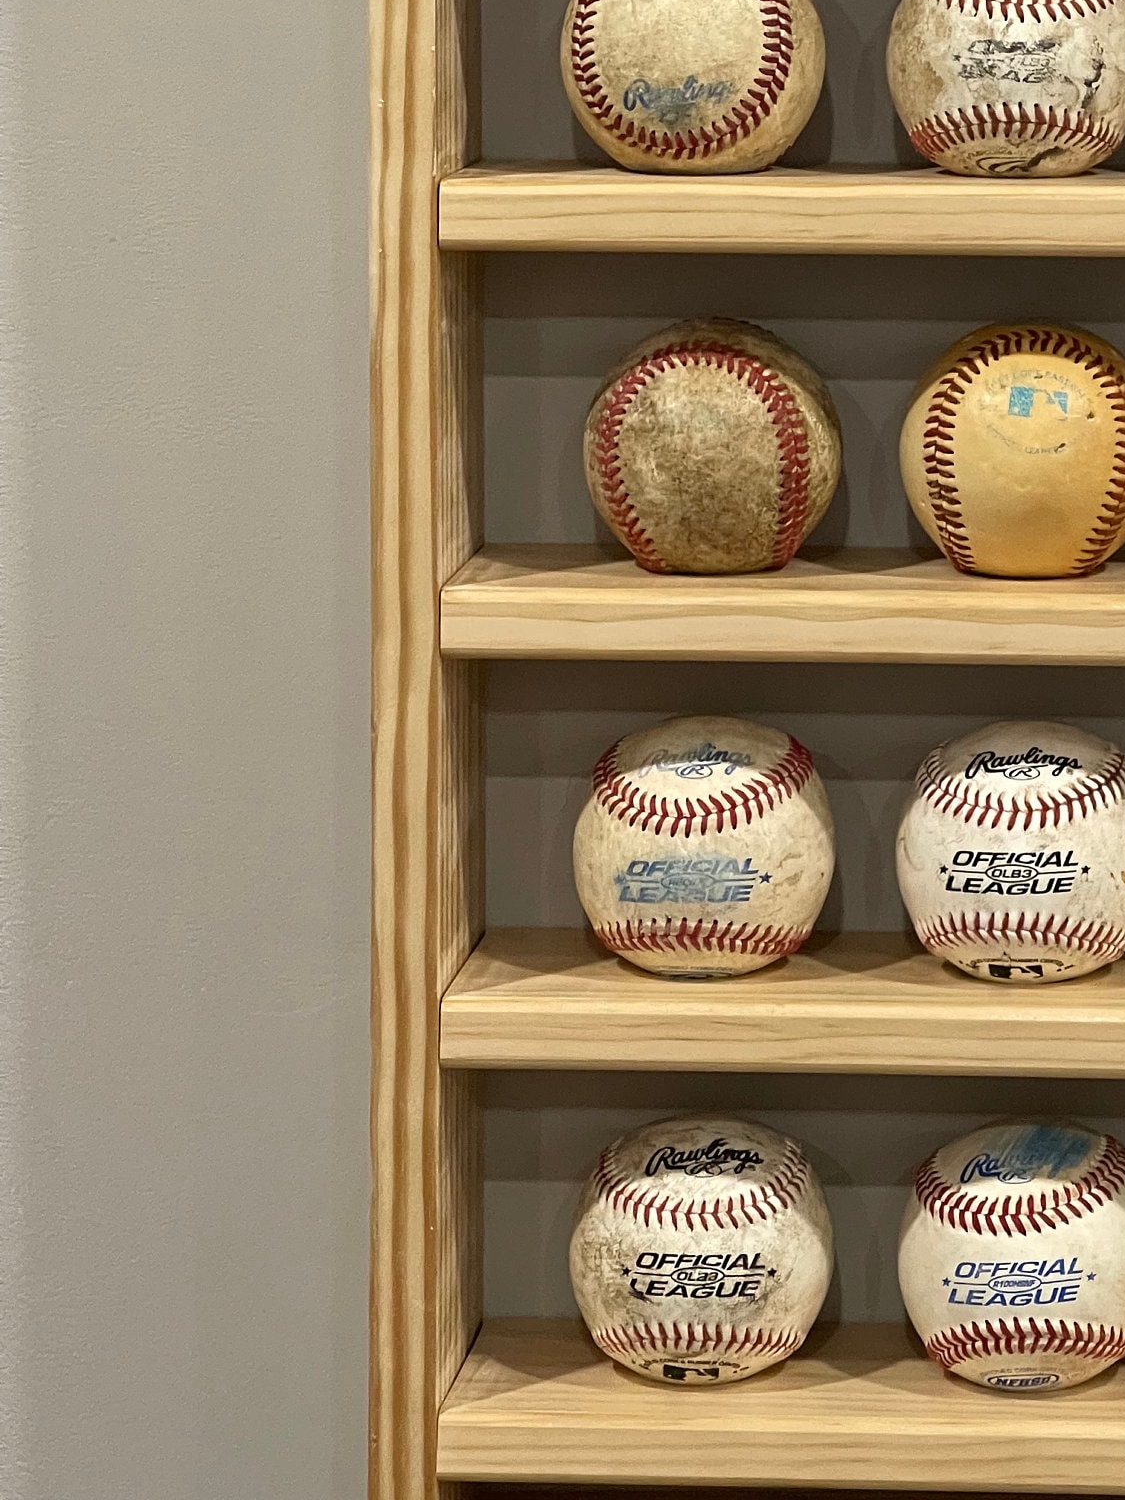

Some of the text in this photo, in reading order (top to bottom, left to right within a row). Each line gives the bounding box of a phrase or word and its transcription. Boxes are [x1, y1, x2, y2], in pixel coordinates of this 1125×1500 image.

[965, 746, 1082, 779] Rawlings
[626, 858, 759, 877] OFFICIAL
[952, 850, 1078, 868] OFFICIAL
[991, 869, 1032, 878] OLB3
[618, 884, 754, 903] LEAGUE
[945, 875, 1075, 895] LEAGUE
[645, 1138, 764, 1177] Rawlings
[635, 1252, 765, 1270] OFFICIAL
[955, 1257, 1083, 1278] OFFICIAL
[629, 1278, 761, 1299] LEAGUE
[948, 1284, 1080, 1306] LEAGUE
